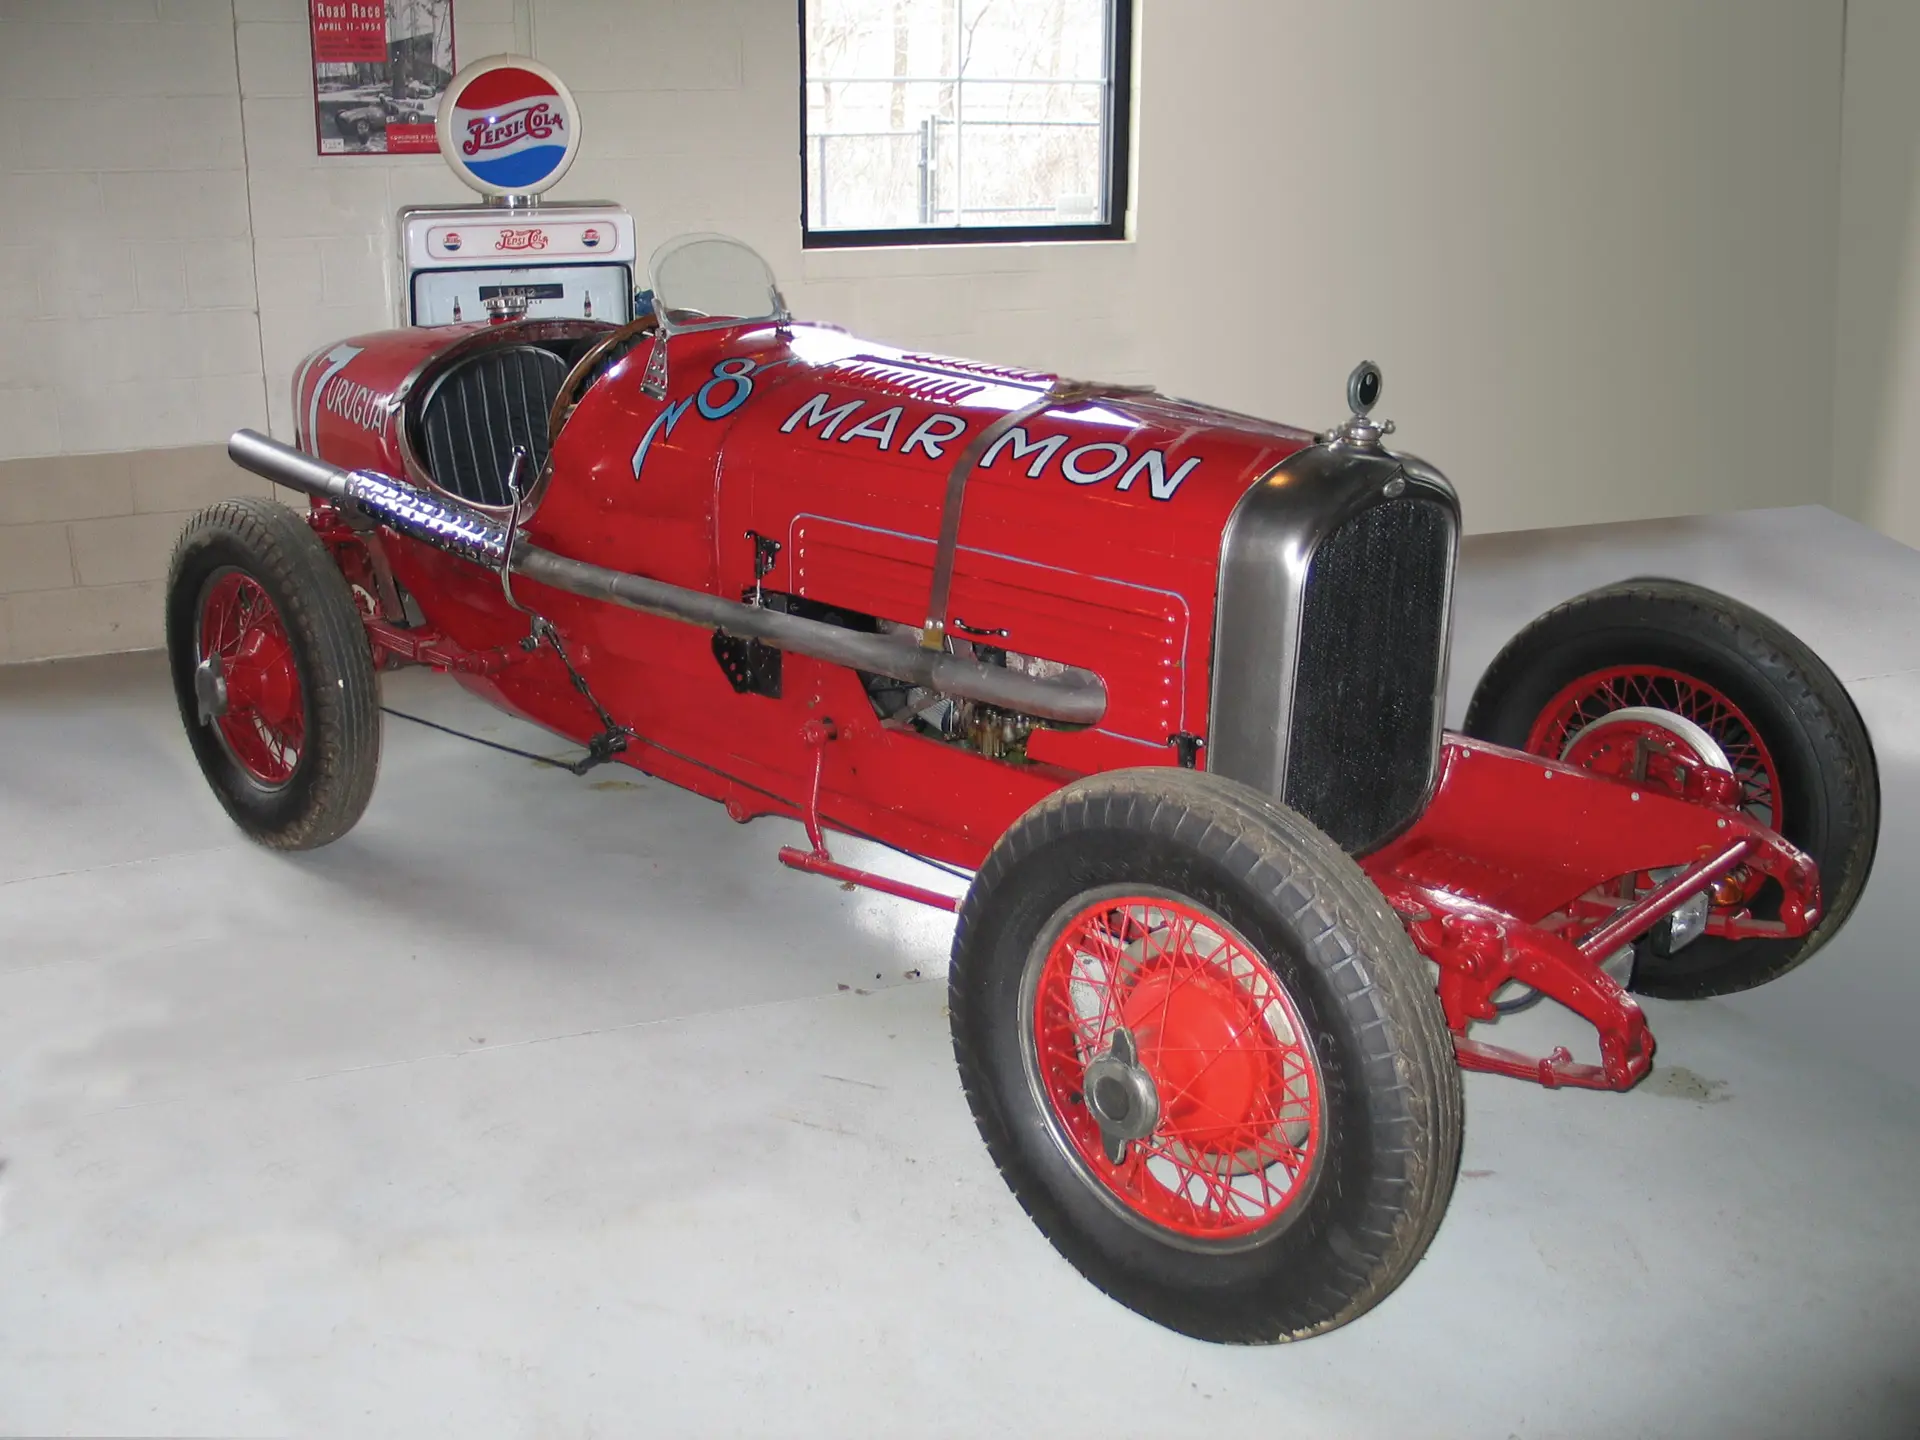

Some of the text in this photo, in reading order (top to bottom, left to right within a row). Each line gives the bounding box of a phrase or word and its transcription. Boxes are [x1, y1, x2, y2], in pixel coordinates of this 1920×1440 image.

[317, 3, 381, 18] Road Race
[318, 22, 342, 31] APRIL
